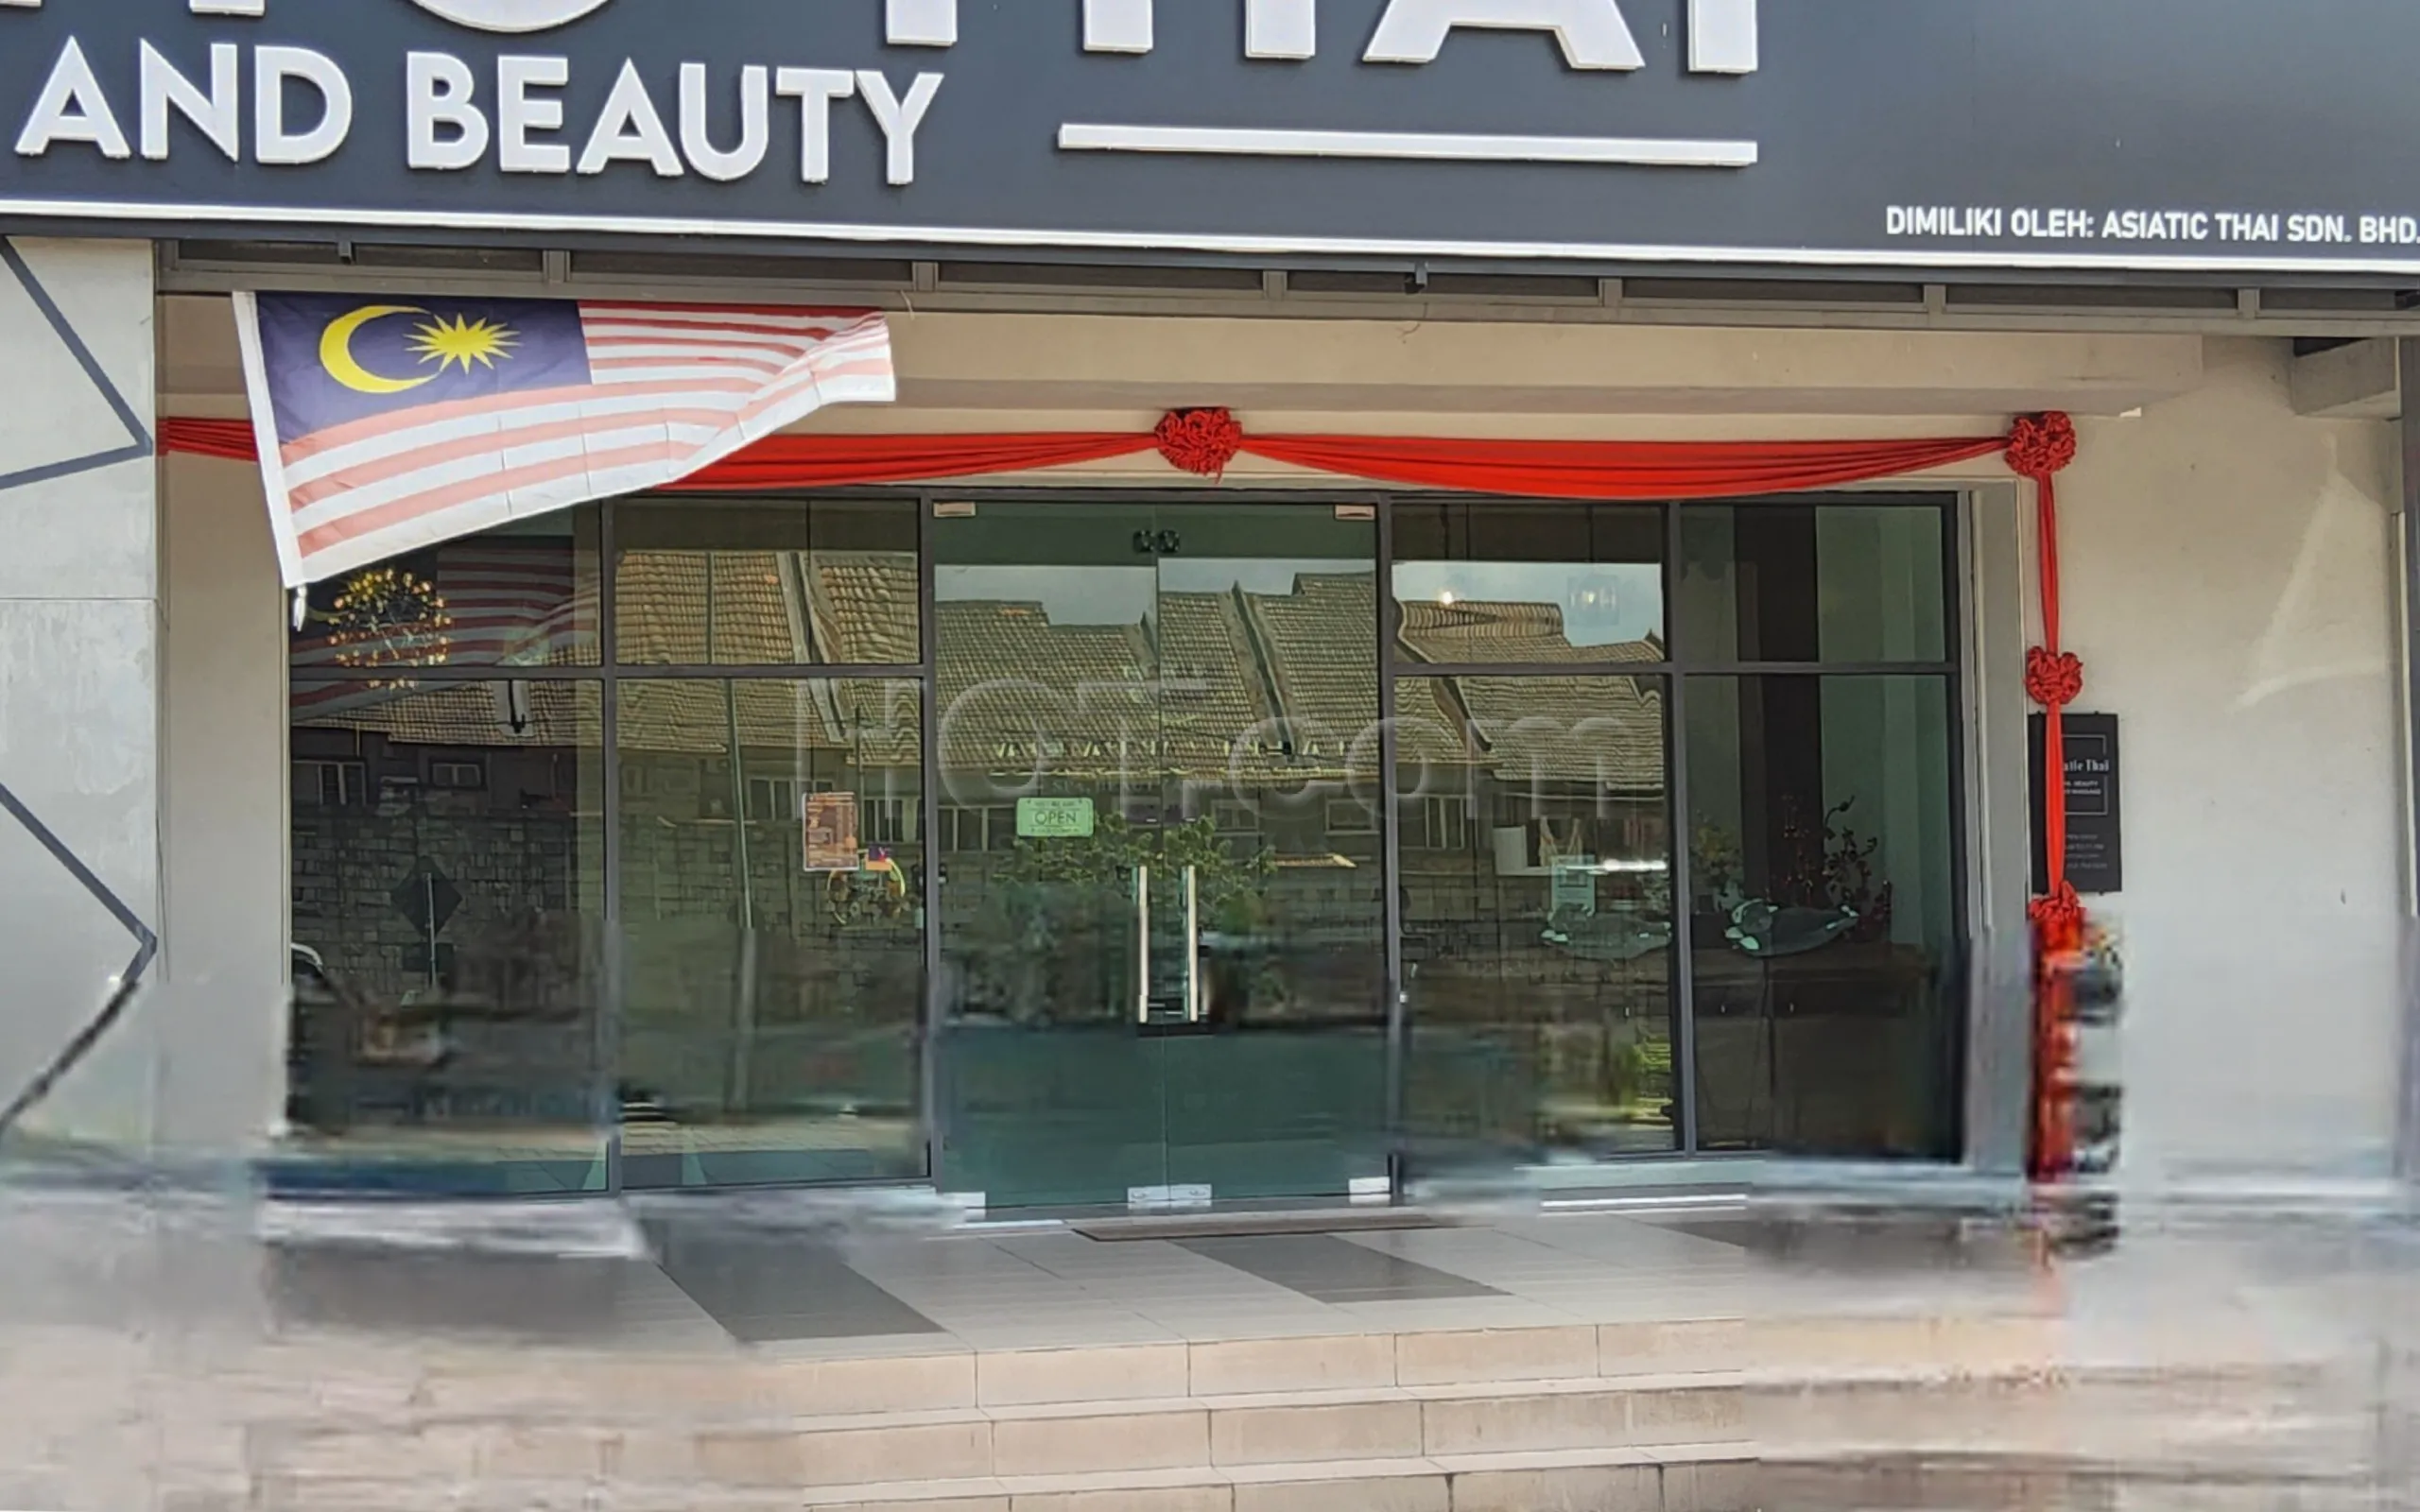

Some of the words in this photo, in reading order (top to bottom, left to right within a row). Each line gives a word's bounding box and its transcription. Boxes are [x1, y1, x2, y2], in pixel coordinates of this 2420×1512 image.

[14, 36, 353, 163] AND
[406, 51, 945, 185] BEAUTY
[1886, 205, 2002, 236] DIMILIKI
[2010, 208, 2095, 238] OLEH:
[2100, 211, 2209, 240] ASIATIC
[2214, 213, 2280, 242] THAI
[2287, 214, 2353, 243] SDN.
[2359, 215, 2420, 244] BHD.
[1034, 811, 1077, 826] OPEN
